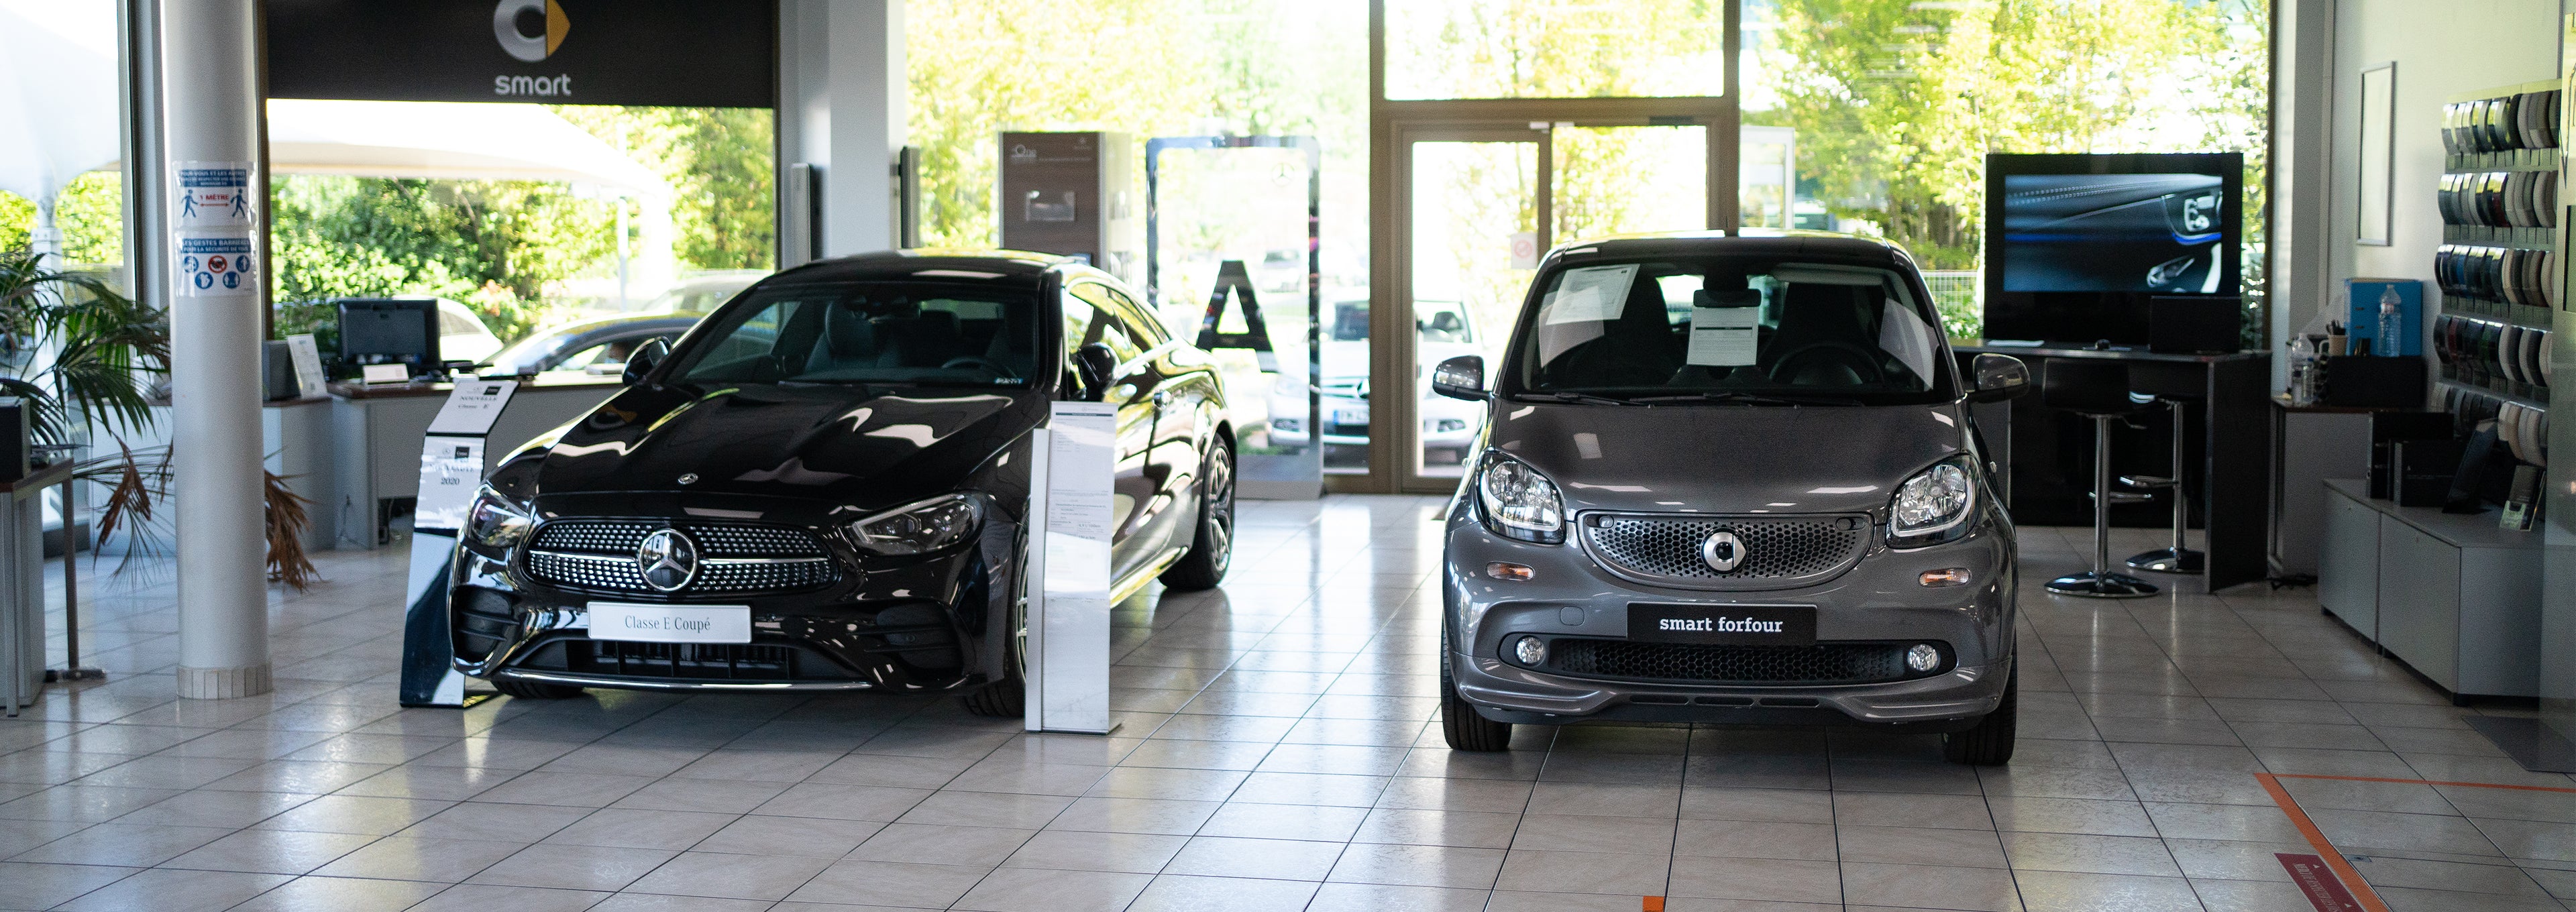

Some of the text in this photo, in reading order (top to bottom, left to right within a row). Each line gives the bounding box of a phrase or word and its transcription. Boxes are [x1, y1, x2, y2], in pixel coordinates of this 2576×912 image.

[495, 74, 572, 96] smart
[440, 477, 460, 485] 2020
[625, 615, 711, 633] Classe E Coupé
[1660, 616, 1783, 632] smart forfour
